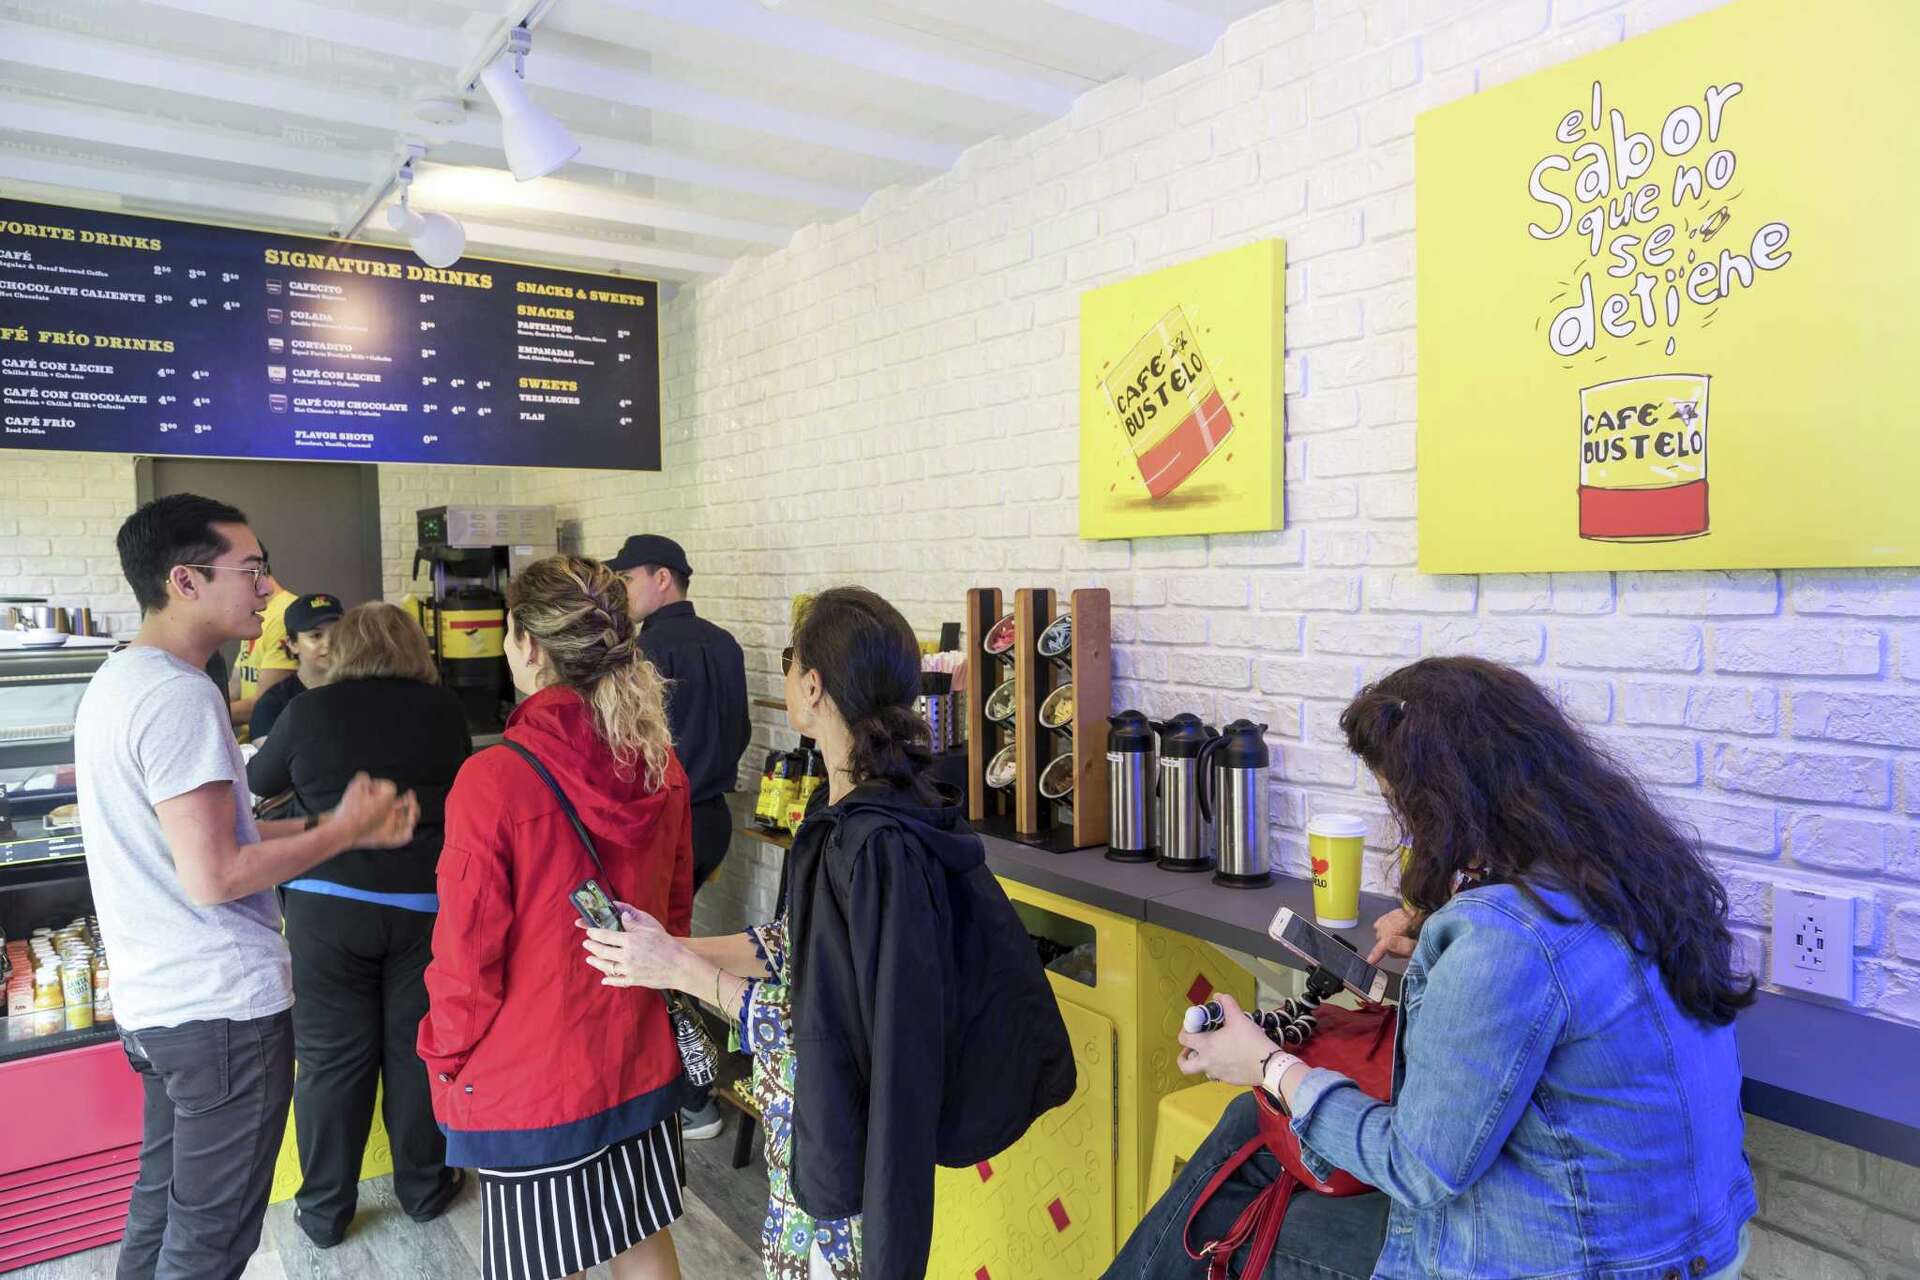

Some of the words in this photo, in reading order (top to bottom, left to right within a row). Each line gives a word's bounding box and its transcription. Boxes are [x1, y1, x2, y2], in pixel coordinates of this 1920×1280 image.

[1556, 80, 1602, 143] el
[1528, 82, 1743, 240] Sabor
[1577, 184, 1660, 256] que
[1672, 150, 1736, 207] no
[80, 230, 162, 251] DRINKS
[1607, 224, 1675, 278] se
[264, 249, 402, 279] SIGNATURE
[407, 265, 493, 289] DRINKS
[0, 281, 78, 296] CHOCOLATE
[81, 288, 146, 303] CALIENTE
[289, 282, 342, 294] CAFECITO
[516, 281, 573, 298] SNACKS
[576, 288, 587, 300] &
[589, 290, 645, 306] SWEETS
[1549, 222, 1792, 356] detiene
[290, 311, 333, 321] COLADA
[517, 305, 575, 320] SNACKS
[517, 321, 572, 333] PASTELITOS
[38, 329, 90, 346] FRÍO
[95, 336, 175, 352] DRINKS
[291, 340, 352, 351] CORTADITO
[518, 346, 574, 358] EMPANADAS
[2, 358, 37, 369] CAFÉ
[40, 362, 67, 371] CON
[70, 363, 114, 374] LECHE
[292, 369, 320, 378] CAFÉ
[322, 371, 344, 380] CON
[347, 372, 381, 382] LECHE
[519, 377, 578, 391] SWEETS
[4, 387, 38, 398] CAFÉ
[41, 390, 68, 399] CON
[71, 392, 147, 404] CHOCOLATE
[519, 393, 544, 402] TRES
[545, 395, 580, 405] LECHES
[1125, 352, 1203, 437] BUSTELO
[293, 398, 321, 407] CAFÉ
[323, 399, 345, 408] CON
[347, 401, 408, 412] CHOCOLATE
[5, 416, 40, 426] CAFÉ
[43, 417, 75, 428] FRÍO
[520, 412, 545, 421] FLAN
[295, 430, 337, 440] FLAVOR
[339, 432, 374, 441] SHOTS
[1583, 431, 1703, 464] BUSTELO
